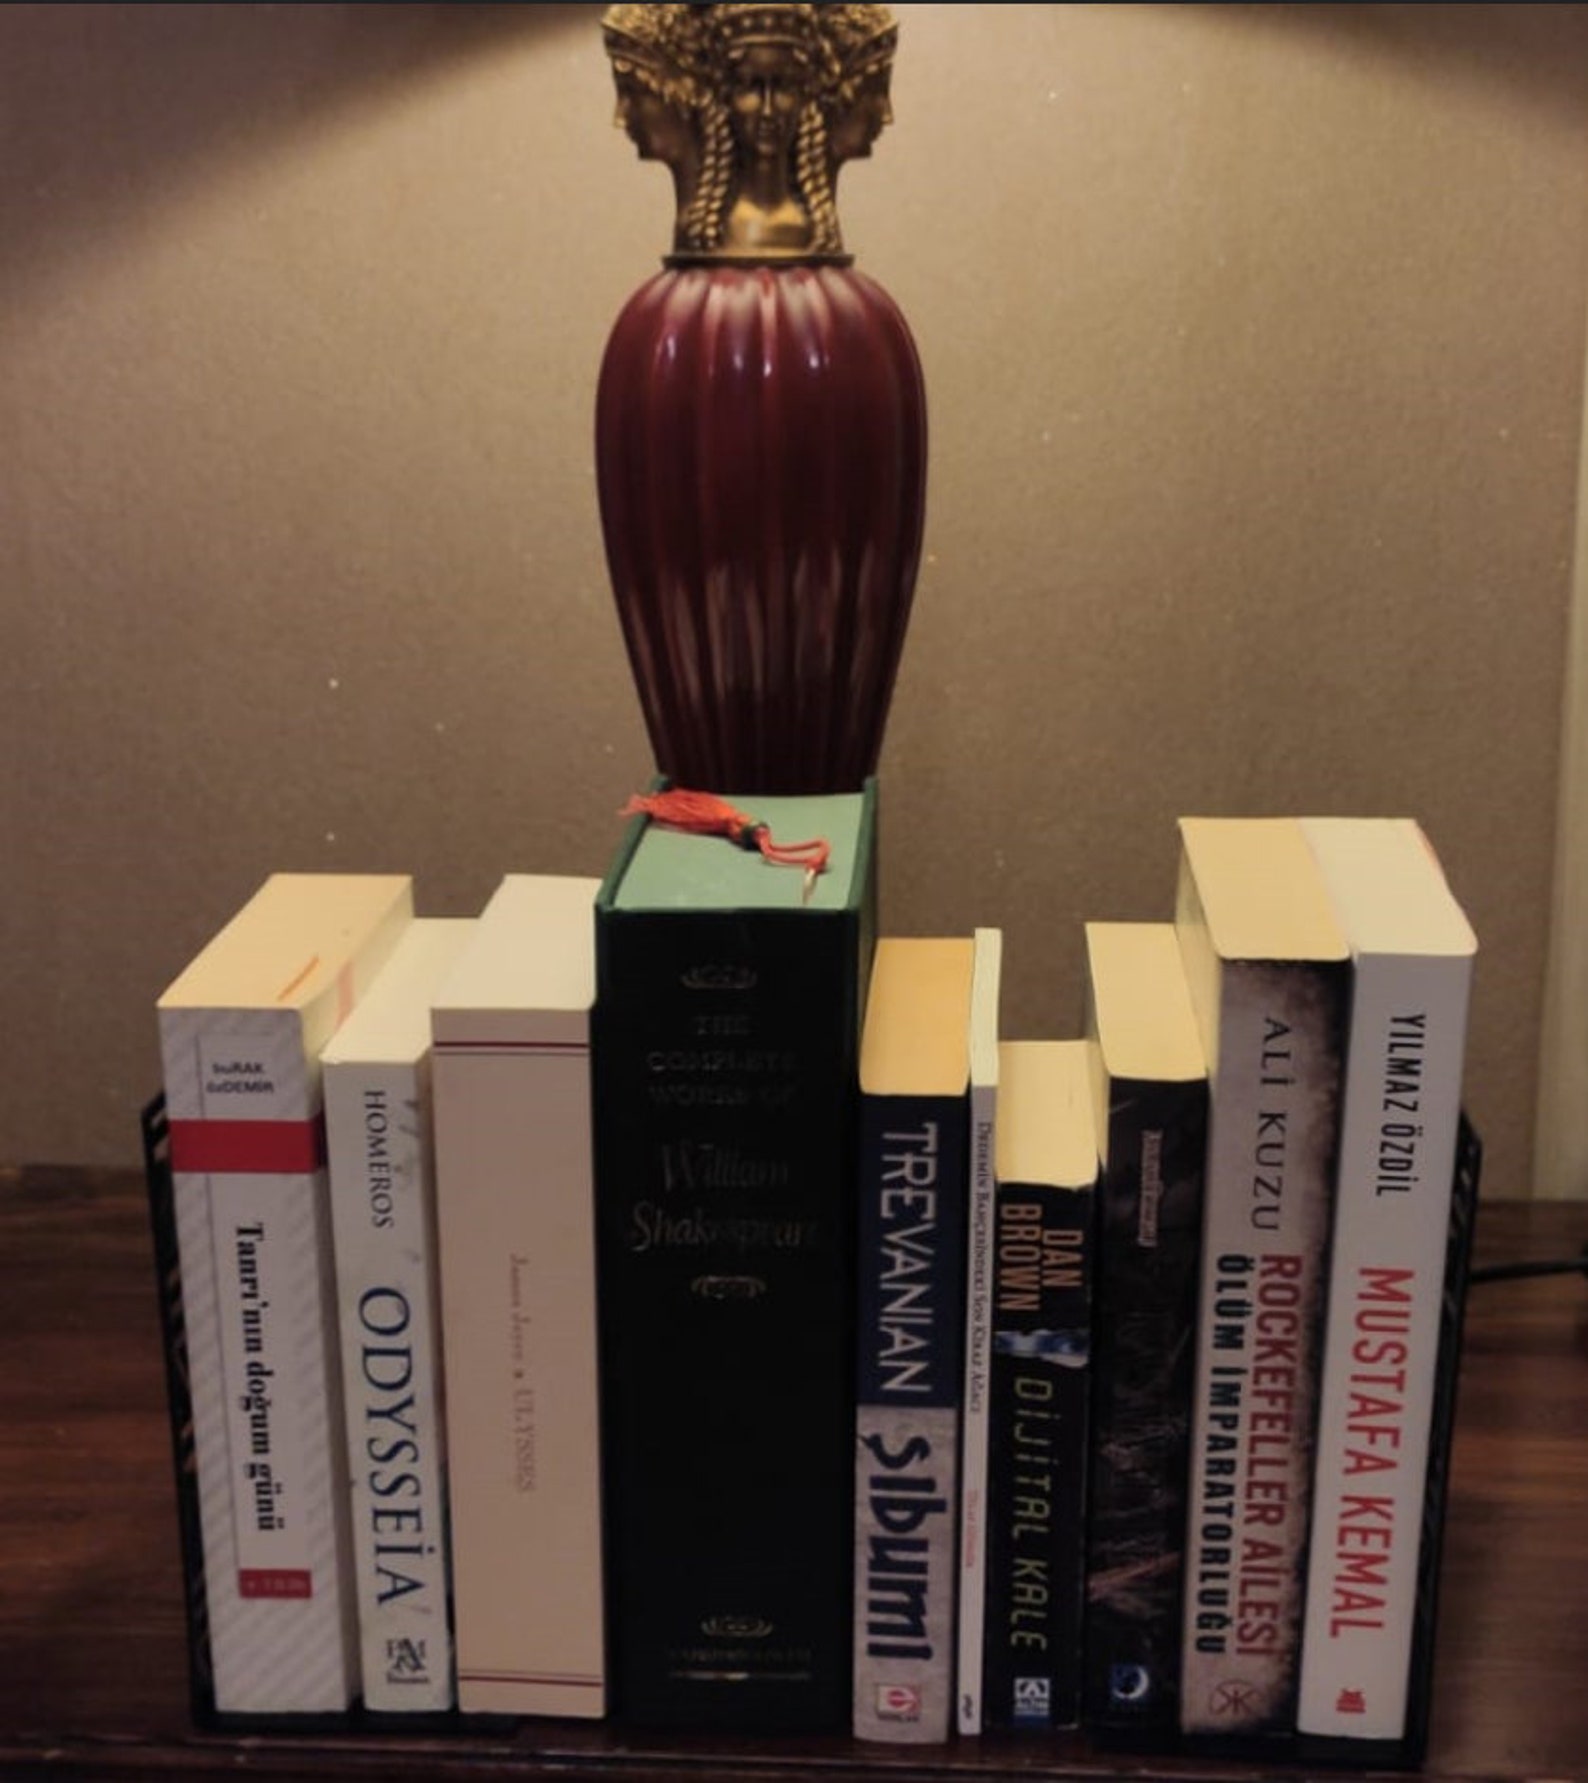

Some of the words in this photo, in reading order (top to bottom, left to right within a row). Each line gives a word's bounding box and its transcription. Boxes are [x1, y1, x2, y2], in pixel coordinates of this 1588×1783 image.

[1260, 1017, 1295, 1086] ALİ
[1382, 1014, 1426, 1111] YILMAZ
[364, 1090, 394, 1229] HOMEROS
[1252, 1111, 1288, 1231] KUZU
[1375, 1123, 1424, 1197] ÖZDİL
[235, 1222, 269, 1353] Tanrı'nın
[878, 1121, 938, 1392] TREVANIAN
[998, 1204, 1042, 1310] BROWN
[1042, 1229, 1084, 1287] DAN
[1213, 1254, 1255, 1350] ÖLÜM
[239, 1361, 275, 1454] doğum
[1243, 1254, 1304, 1526] ROCKEFELLER
[1343, 1268, 1415, 1476] MUSTAFA
[243, 1463, 284, 1530] günü
[358, 1286, 435, 1605] ODYSSEİA
[1012, 1377, 1062, 1540] DİJİTAL
[1195, 1366, 1248, 1654] İMPARATORLUĞU
[1330, 1495, 1396, 1639] KEMAL
[1010, 1557, 1048, 1650] KALE
